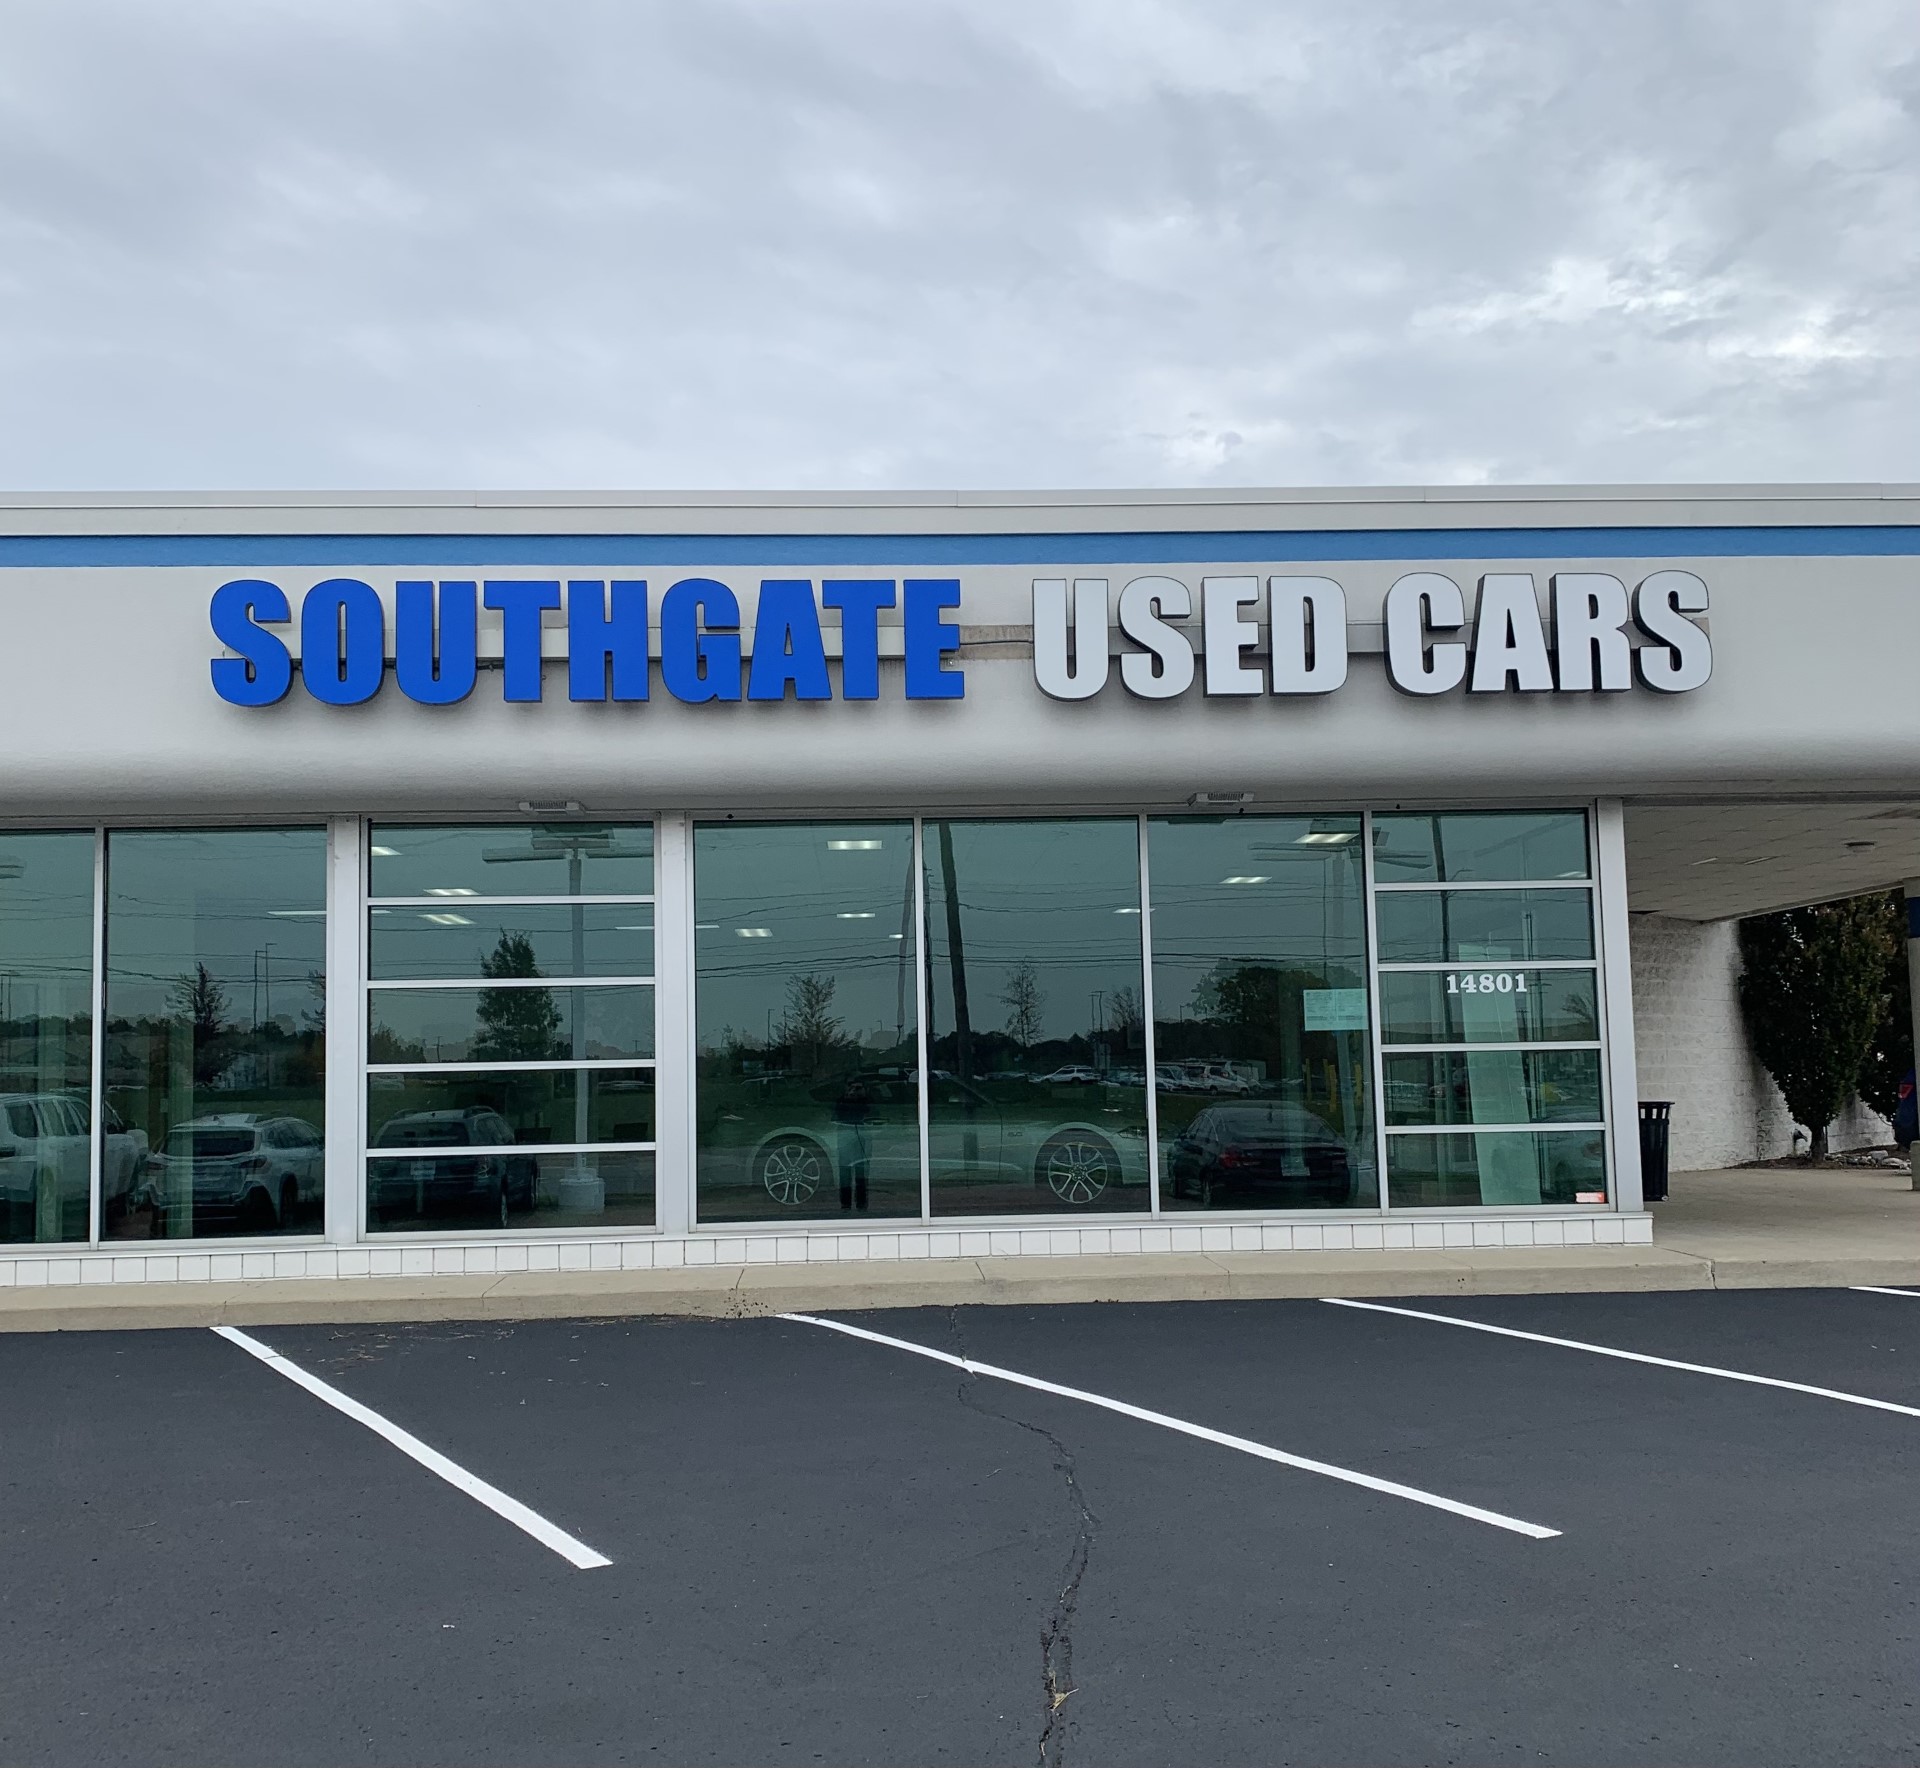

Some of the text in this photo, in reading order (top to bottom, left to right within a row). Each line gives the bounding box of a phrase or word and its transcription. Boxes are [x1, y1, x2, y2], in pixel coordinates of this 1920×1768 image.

[210, 570, 1713, 706] SOUTHGATE USED CARS
[1446, 973, 1528, 994] 14801
